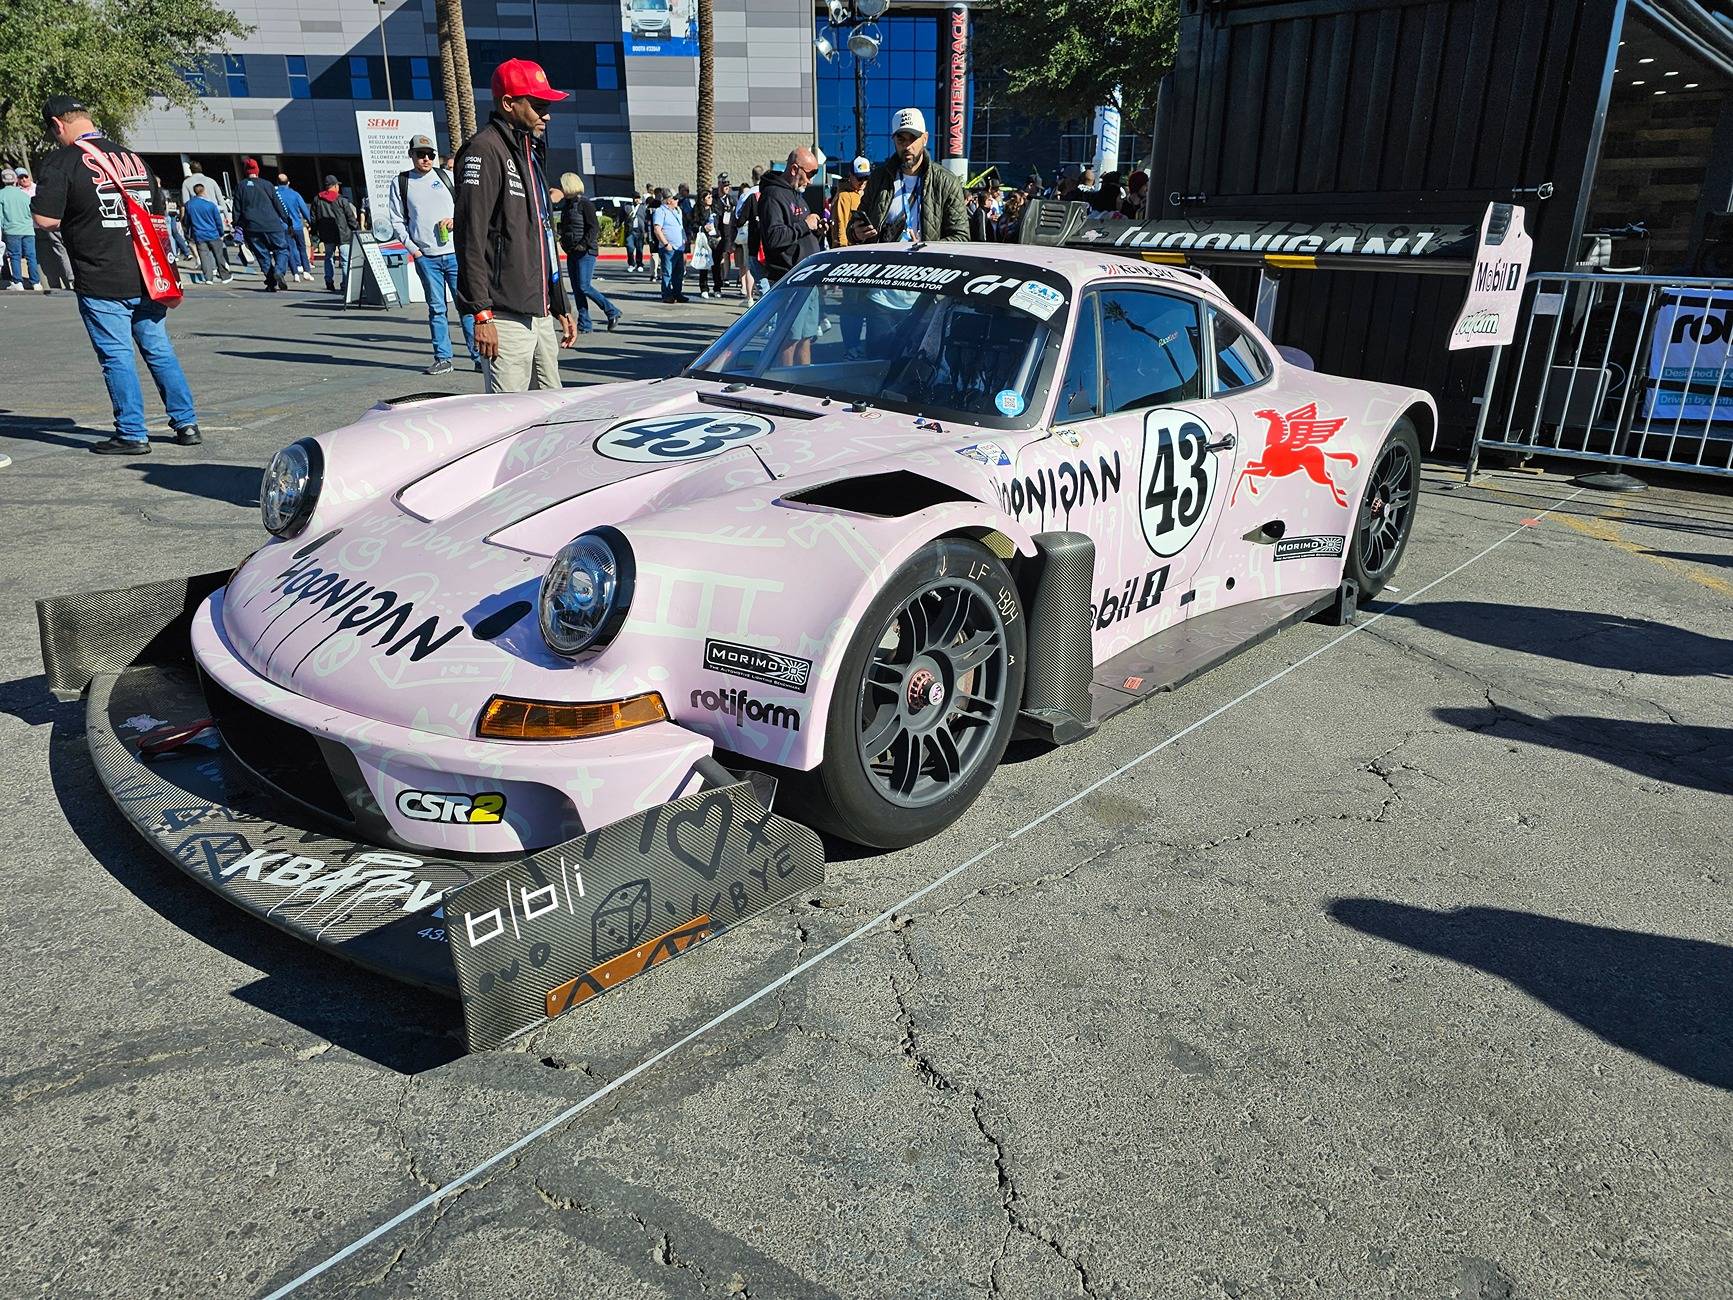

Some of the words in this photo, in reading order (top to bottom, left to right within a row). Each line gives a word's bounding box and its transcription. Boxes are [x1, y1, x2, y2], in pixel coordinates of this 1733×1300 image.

[949, 11, 966, 155] MASTERTRACK
[367, 118, 399, 127] SEMA
[82, 152, 148, 185] SMA
[828, 263, 879, 278] GRAN
[877, 264, 964, 285] TURISMO
[857, 279, 892, 287] DRIVING
[891, 280, 943, 291] SIMULATOR
[1475, 262, 1508, 292] Mobil
[1664, 367, 1713, 378] Desined
[1694, 395, 1707, 406] by
[610, 416, 763, 458] 43
[1145, 421, 1208, 537] 43
[968, 561, 990, 580] LF
[1089, 576, 1140, 632] bil
[720, 667, 751, 678] AUTOMOTIVE
[751, 674, 773, 683] LIGHTING
[773, 680, 801, 690] BENCHMARK
[690, 688, 801, 731] rotiform
[398, 792, 504, 823] CSR2
